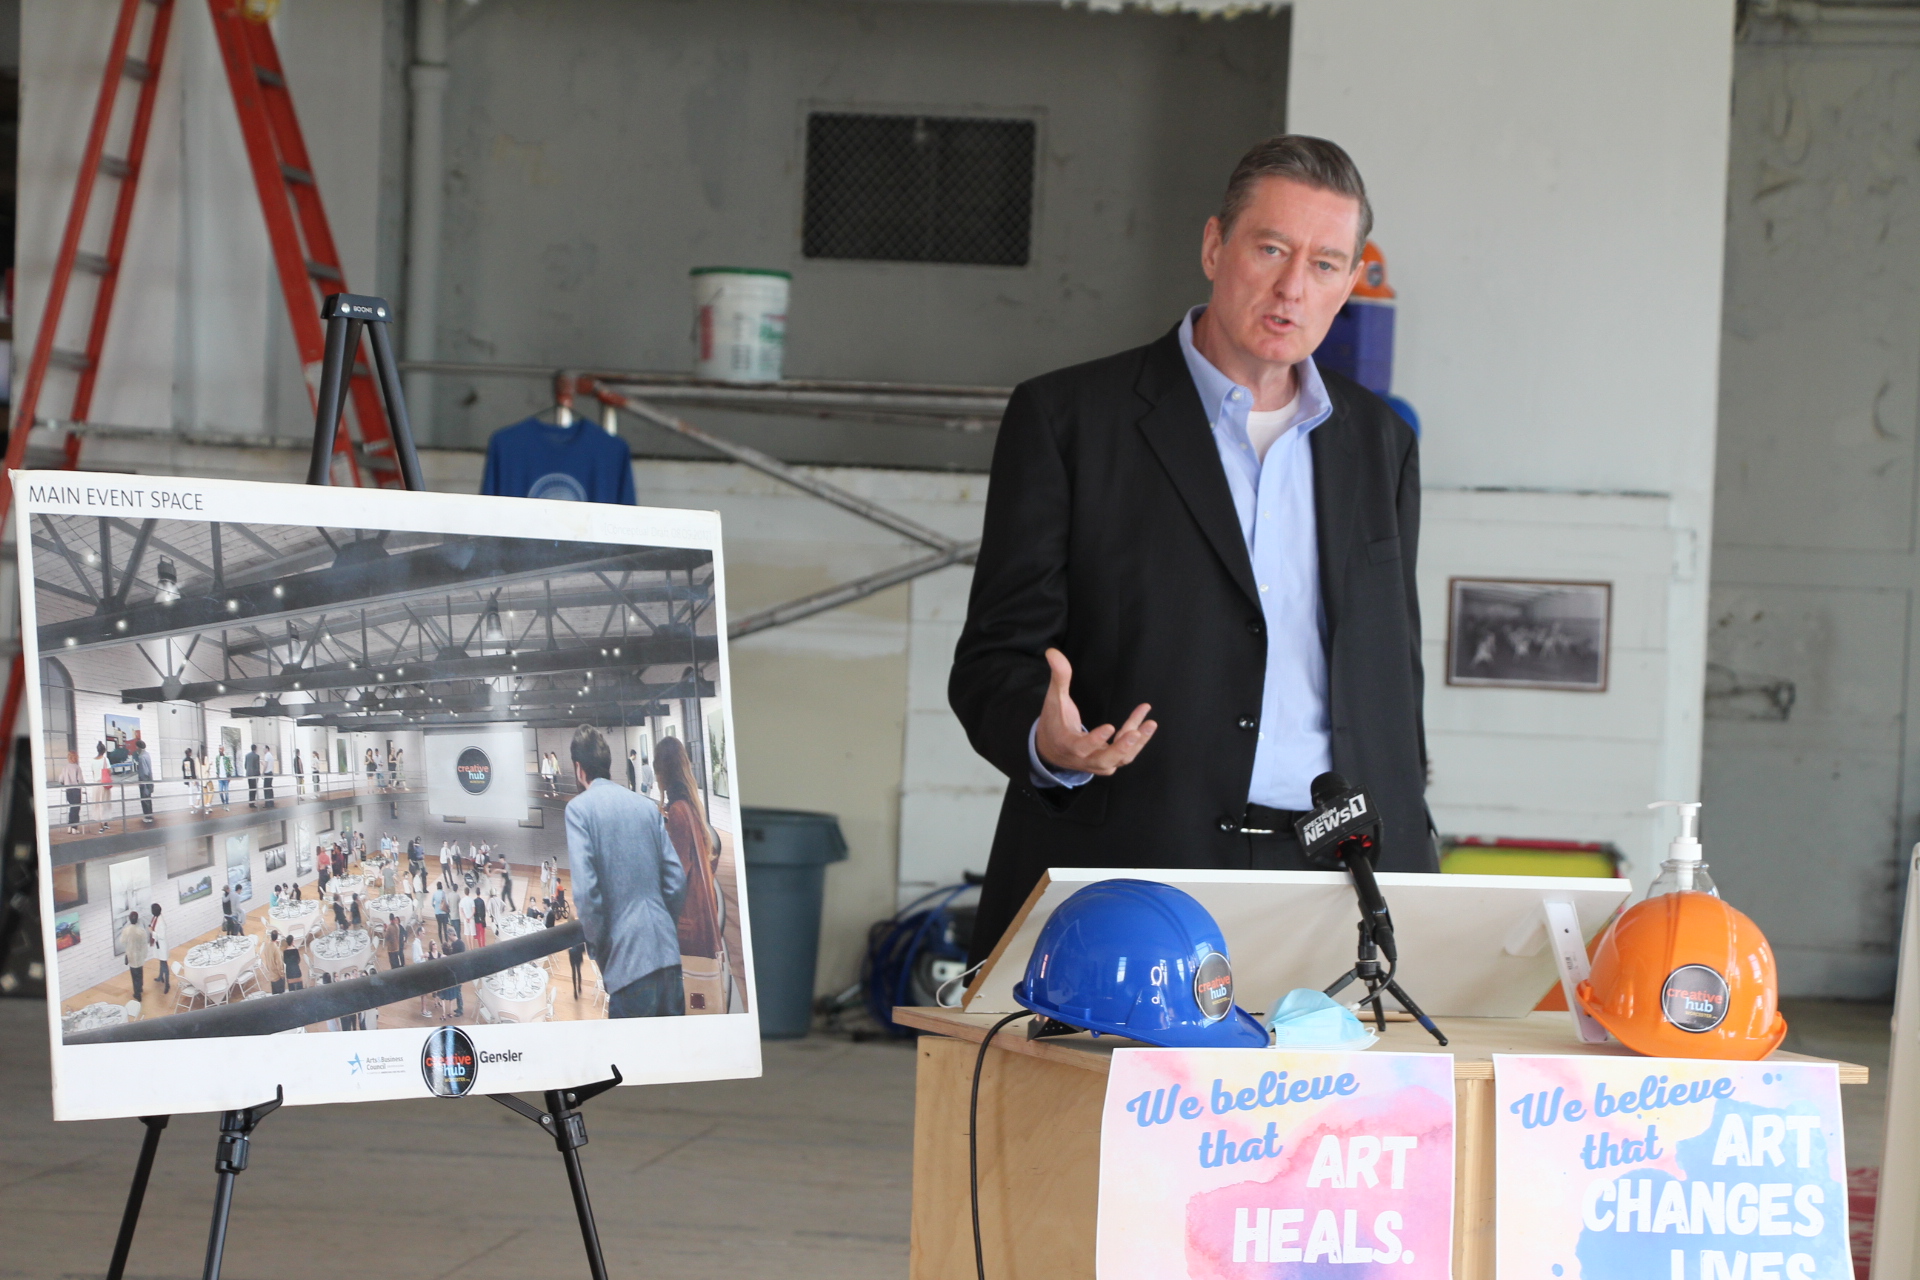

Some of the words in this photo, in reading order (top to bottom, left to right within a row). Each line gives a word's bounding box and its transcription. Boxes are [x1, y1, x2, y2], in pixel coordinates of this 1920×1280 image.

[353, 305, 373, 314] BOONE
[29, 485, 80, 505] MAIN
[86, 488, 144, 507] EVENT
[150, 490, 204, 510] SPACE
[457, 764, 489, 773] creative
[468, 770, 485, 780] hub
[1303, 807, 1338, 832] SPECTRUM
[1198, 974, 1231, 993] creative
[1210, 984, 1227, 1000] hub
[1666, 988, 1723, 1004] creative
[1685, 996, 1713, 1013] hub
[479, 1049, 523, 1064] Gensler
[366, 1062, 387, 1071] Council
[443, 1062, 466, 1077] hub
[1126, 1083, 1204, 1127] We
[1209, 1070, 1360, 1115] believe
[1509, 1086, 1587, 1129] We
[1593, 1074, 1736, 1118] believe
[1582, 1124, 1664, 1170] that
[1711, 1113, 1821, 1169] ART
[1198, 1121, 1283, 1169] that
[1306, 1134, 1418, 1190] ART
[1581, 1178, 1825, 1237] CHANGES
[1232, 1207, 1415, 1265] HEALS.
